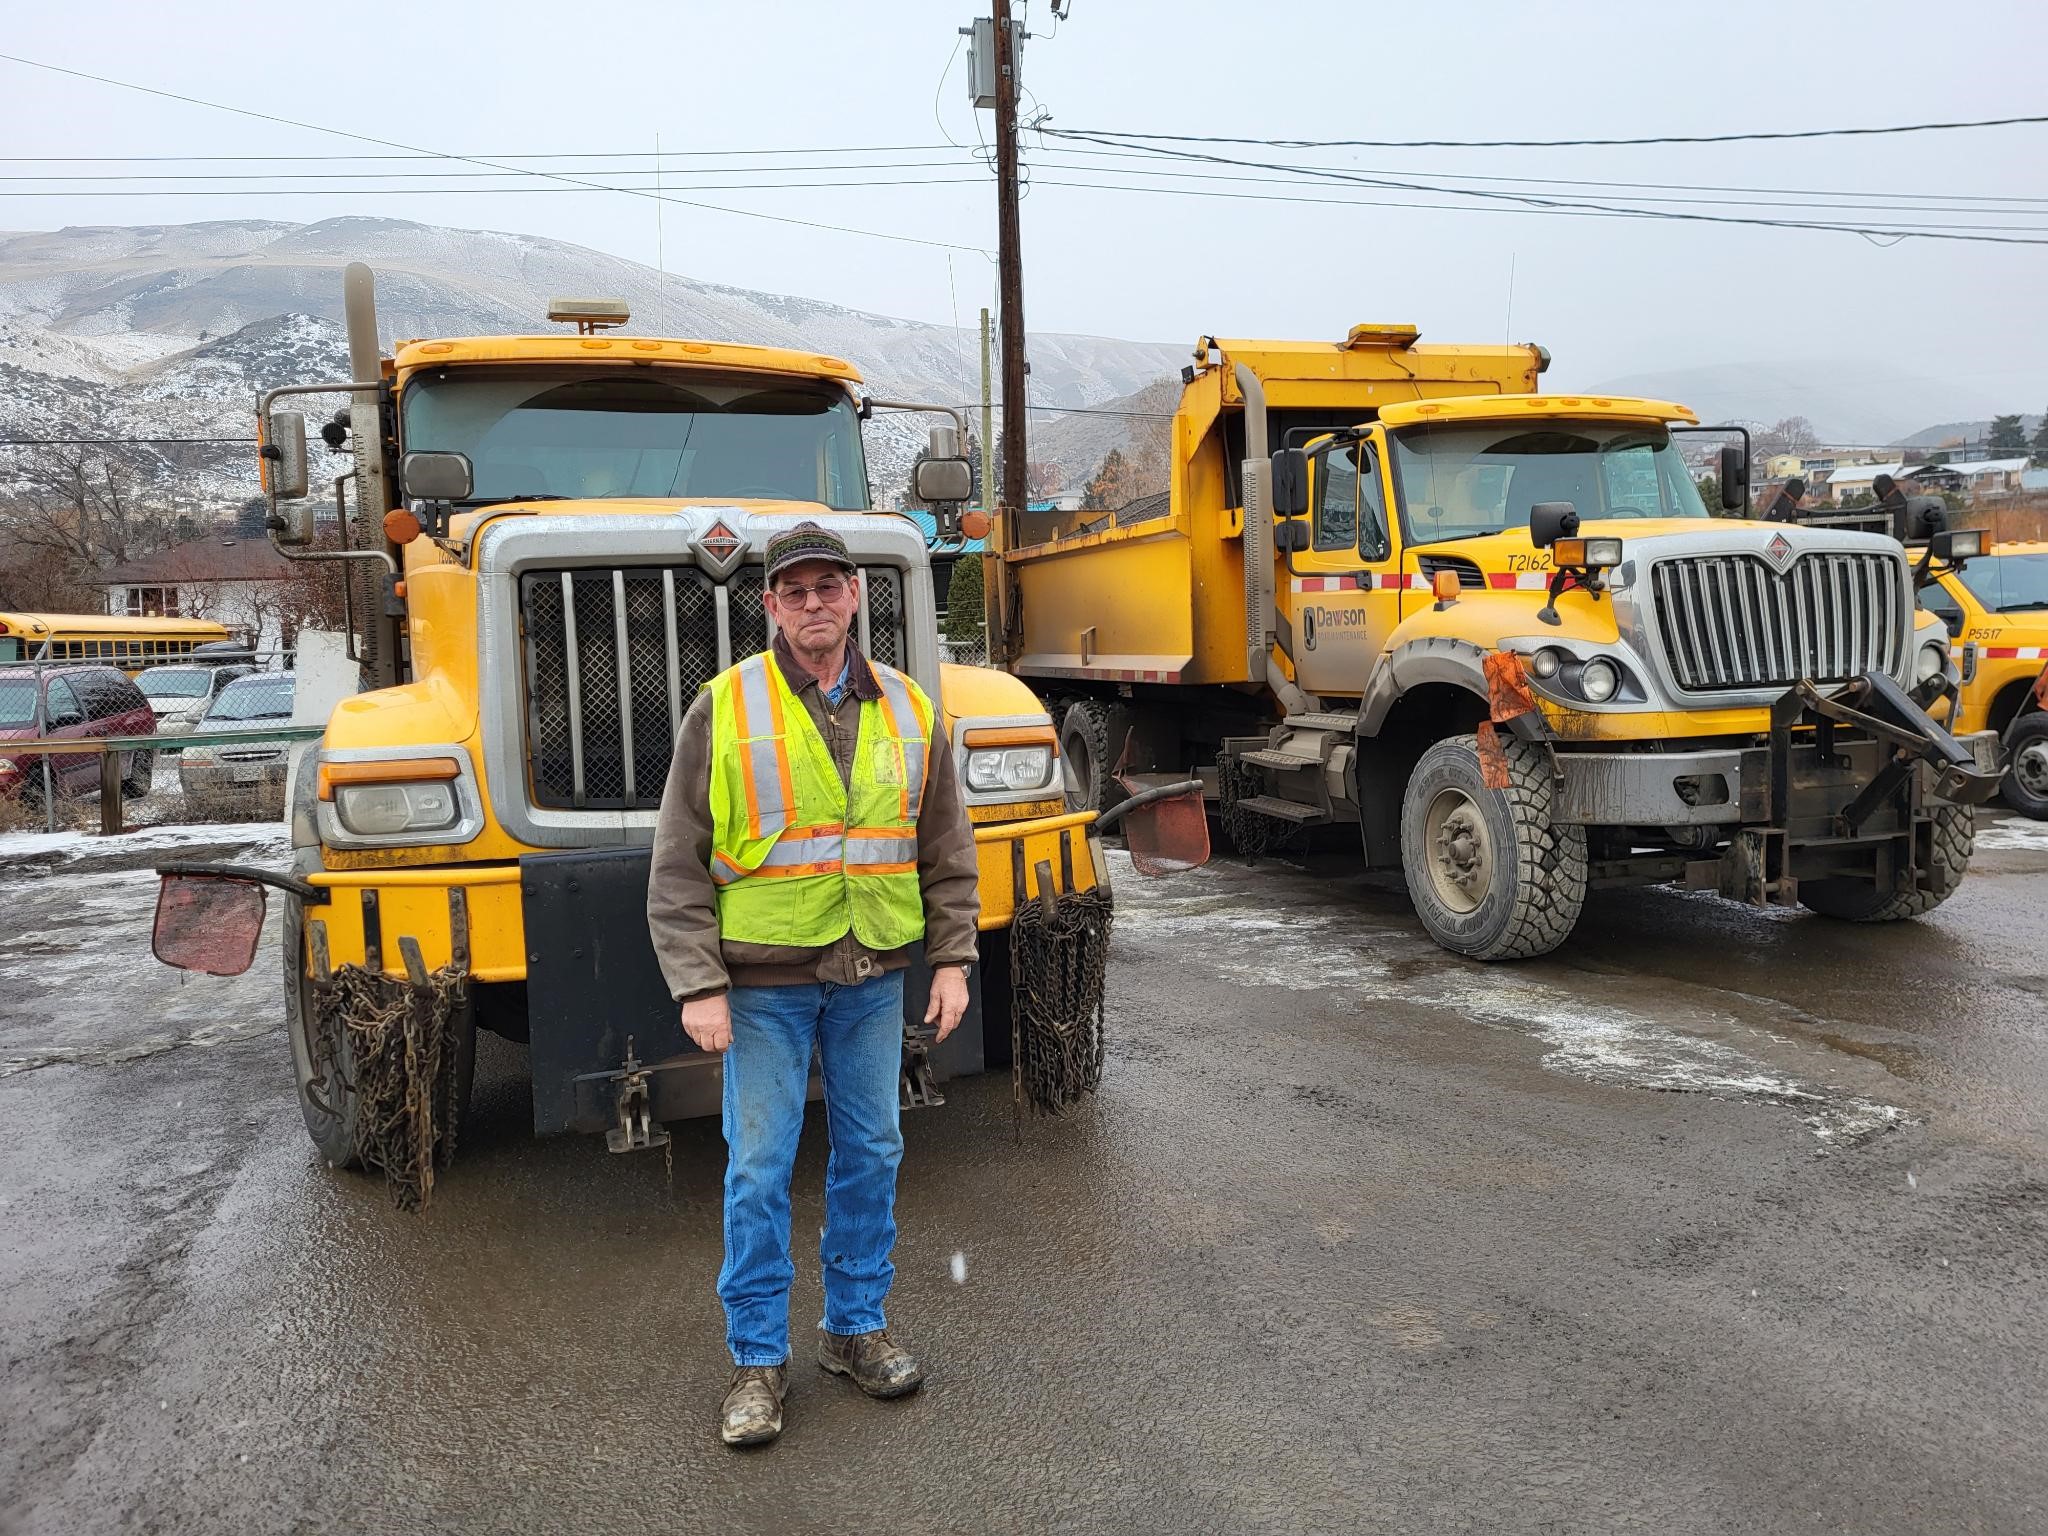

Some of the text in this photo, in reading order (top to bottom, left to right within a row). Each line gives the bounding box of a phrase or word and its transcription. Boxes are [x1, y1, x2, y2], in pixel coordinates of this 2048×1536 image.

[1507, 553, 1551, 571] T2162
[1316, 606, 1366, 627] Dawson
[1968, 628, 2002, 640] P5517
